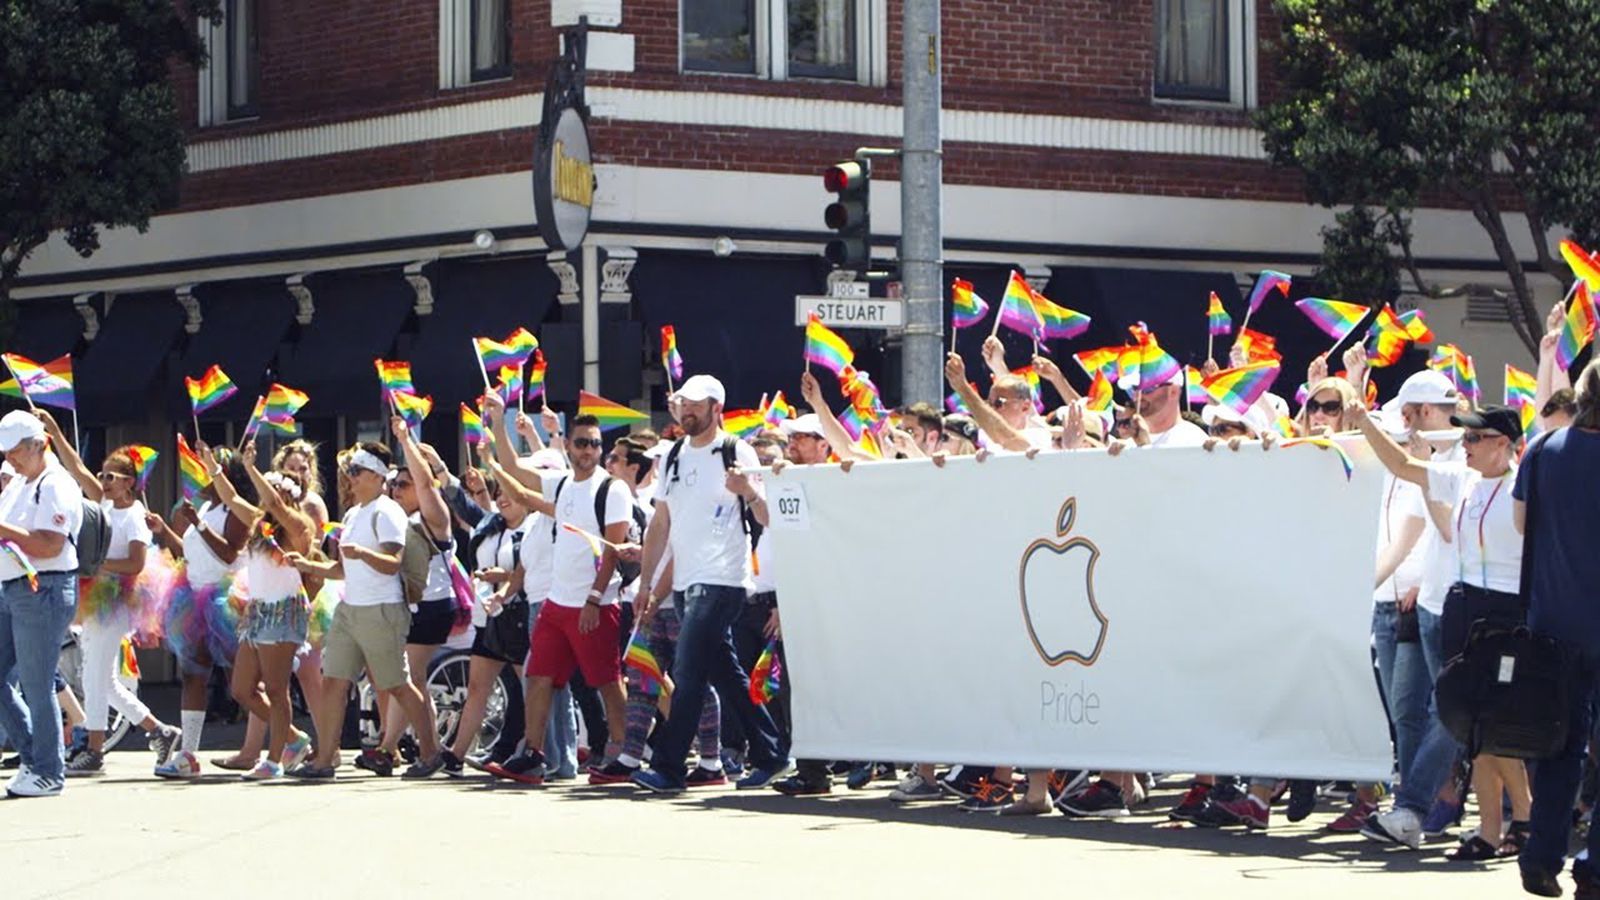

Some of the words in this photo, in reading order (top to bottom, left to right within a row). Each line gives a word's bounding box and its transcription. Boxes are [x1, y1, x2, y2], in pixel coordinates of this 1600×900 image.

[836, 284, 854, 295] 100
[817, 304, 885, 321] STEUART
[779, 497, 800, 515] 037
[1041, 679, 1100, 725] Pride
